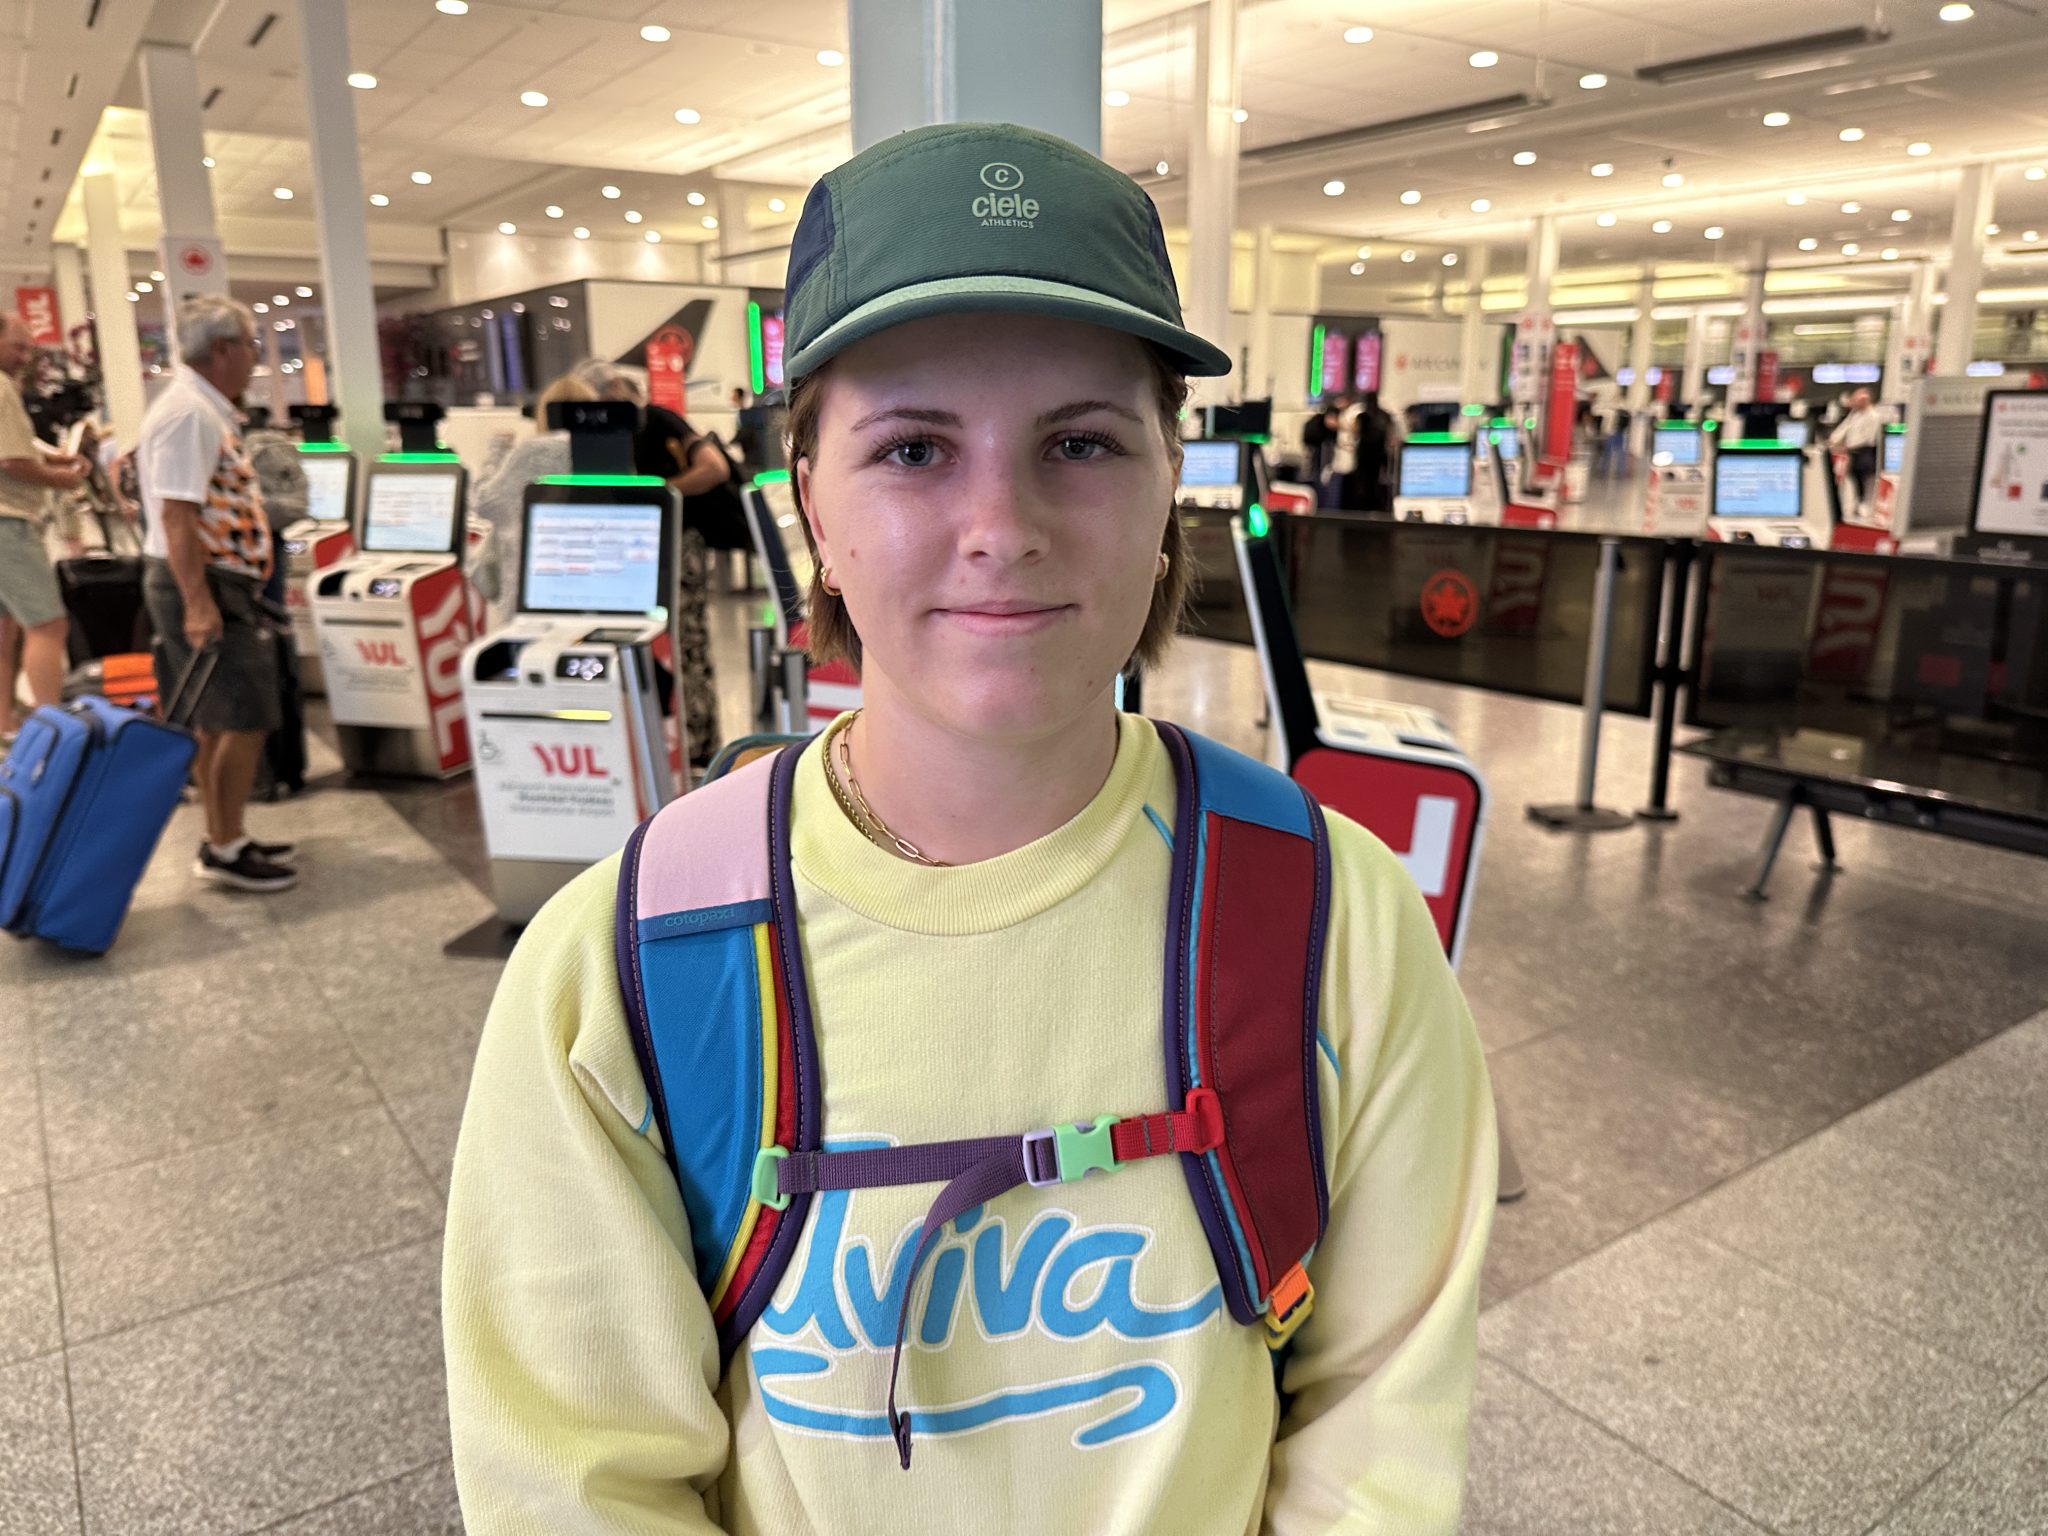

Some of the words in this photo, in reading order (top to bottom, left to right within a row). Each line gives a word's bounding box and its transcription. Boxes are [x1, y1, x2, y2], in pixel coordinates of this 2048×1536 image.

[972, 193, 1040, 219] ciele
[981, 219, 1034, 229] ATHLETICS
[530, 741, 611, 779] YUL
[664, 907, 737, 929] cotopaxi
